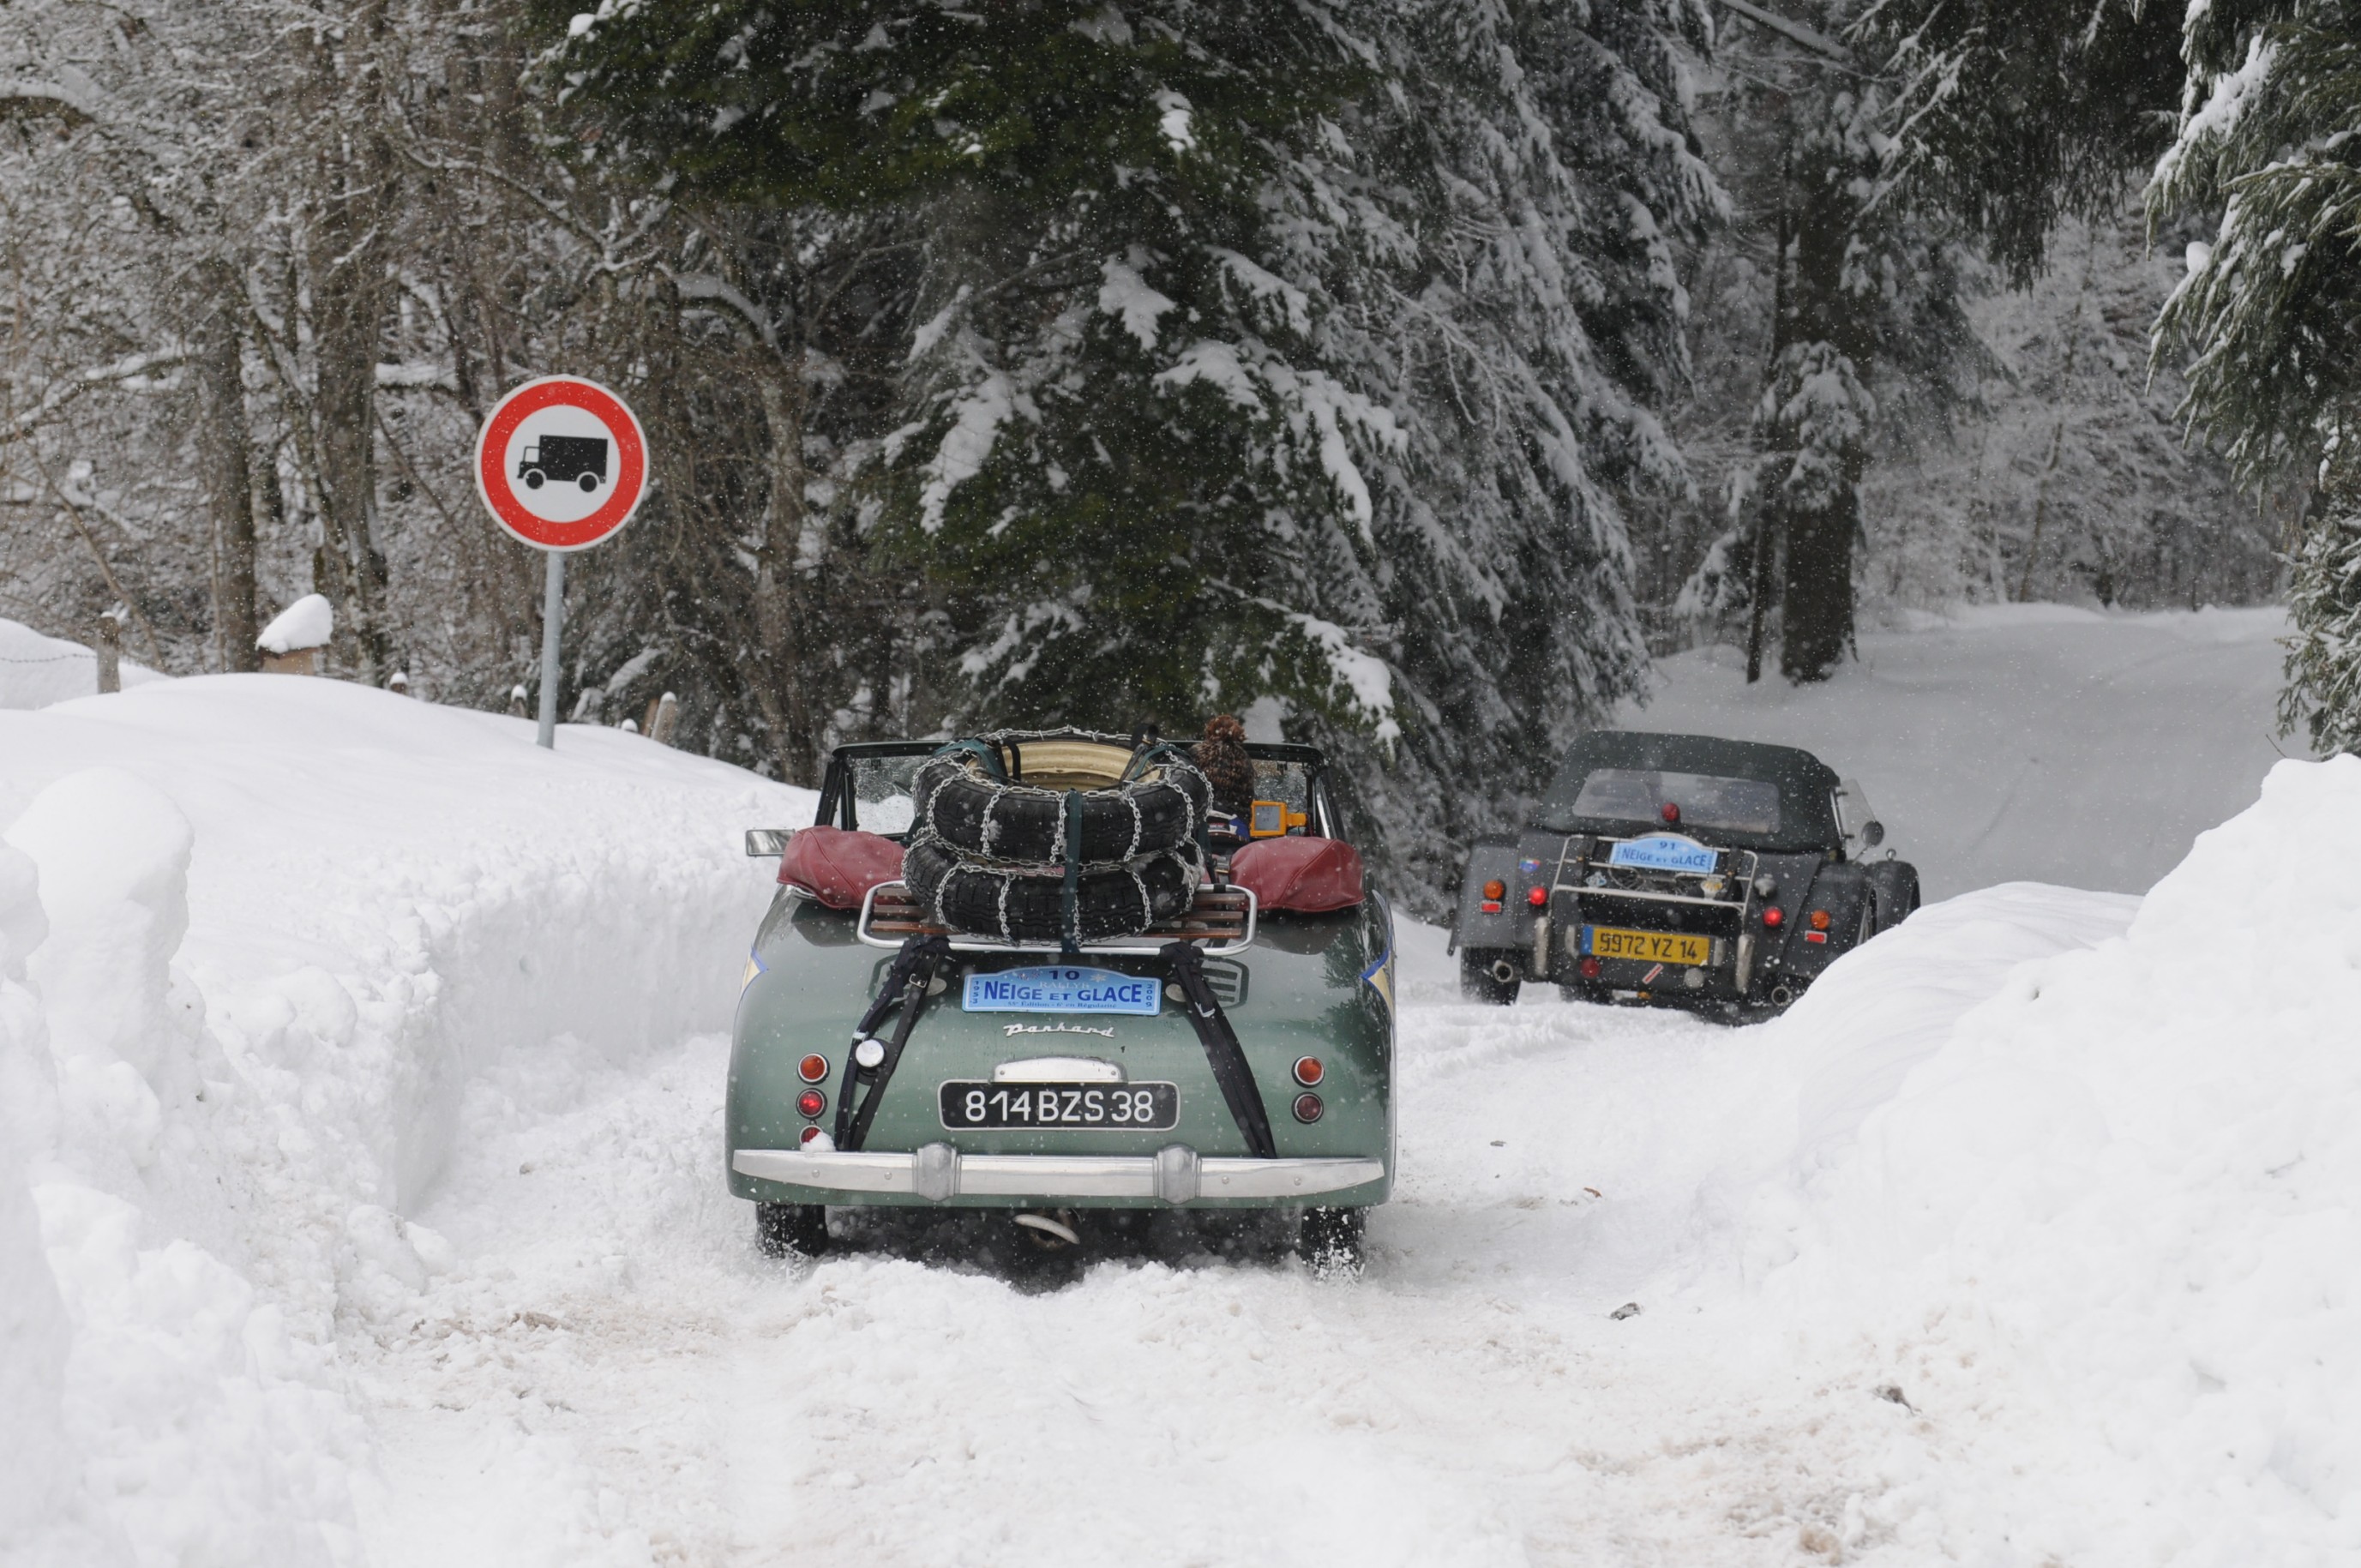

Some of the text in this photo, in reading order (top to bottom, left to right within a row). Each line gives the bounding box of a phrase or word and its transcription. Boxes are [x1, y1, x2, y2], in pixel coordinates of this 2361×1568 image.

[1660, 841, 1675, 850] 91
[1622, 848, 1653, 862] NEIGE
[1671, 855, 1707, 867] GLACE
[1600, 933, 1697, 958] 9972 YZ 14
[1049, 970, 1080, 980] 10
[984, 981, 1042, 1000] NEIGE
[1078, 983, 1142, 1003] GLACE
[965, 1090, 1153, 1122] 814 BZS 38
